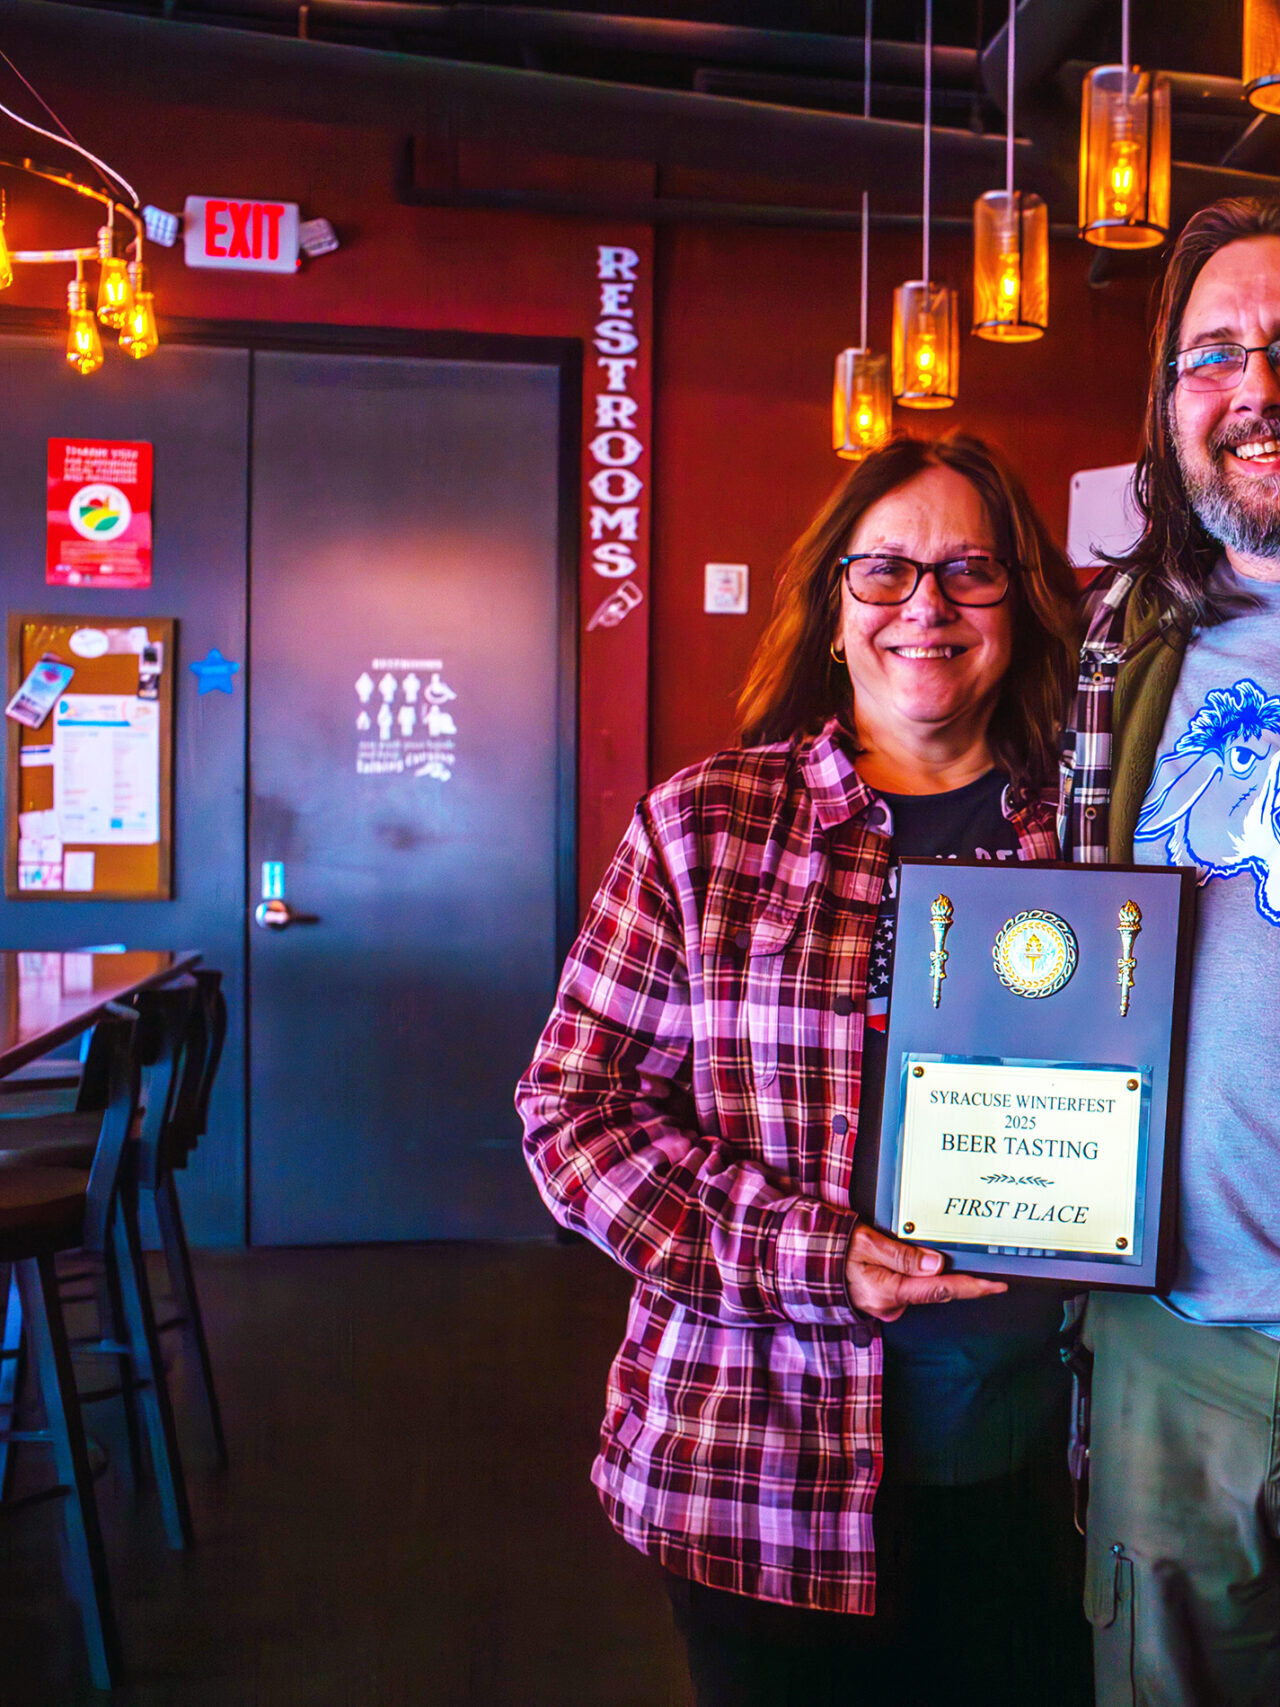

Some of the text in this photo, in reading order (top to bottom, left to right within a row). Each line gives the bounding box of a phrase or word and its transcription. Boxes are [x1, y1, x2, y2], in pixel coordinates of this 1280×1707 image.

[205, 200, 284, 260] EXIT
[588, 245, 643, 578] RESTROOMS
[930, 1090, 1116, 1113] SYRACUSE WINTERFEST
[1004, 1115, 1036, 1130] 2025
[942, 1133, 1098, 1160] BEER TASTING
[944, 1198, 1089, 1224] FIRST PLACE
